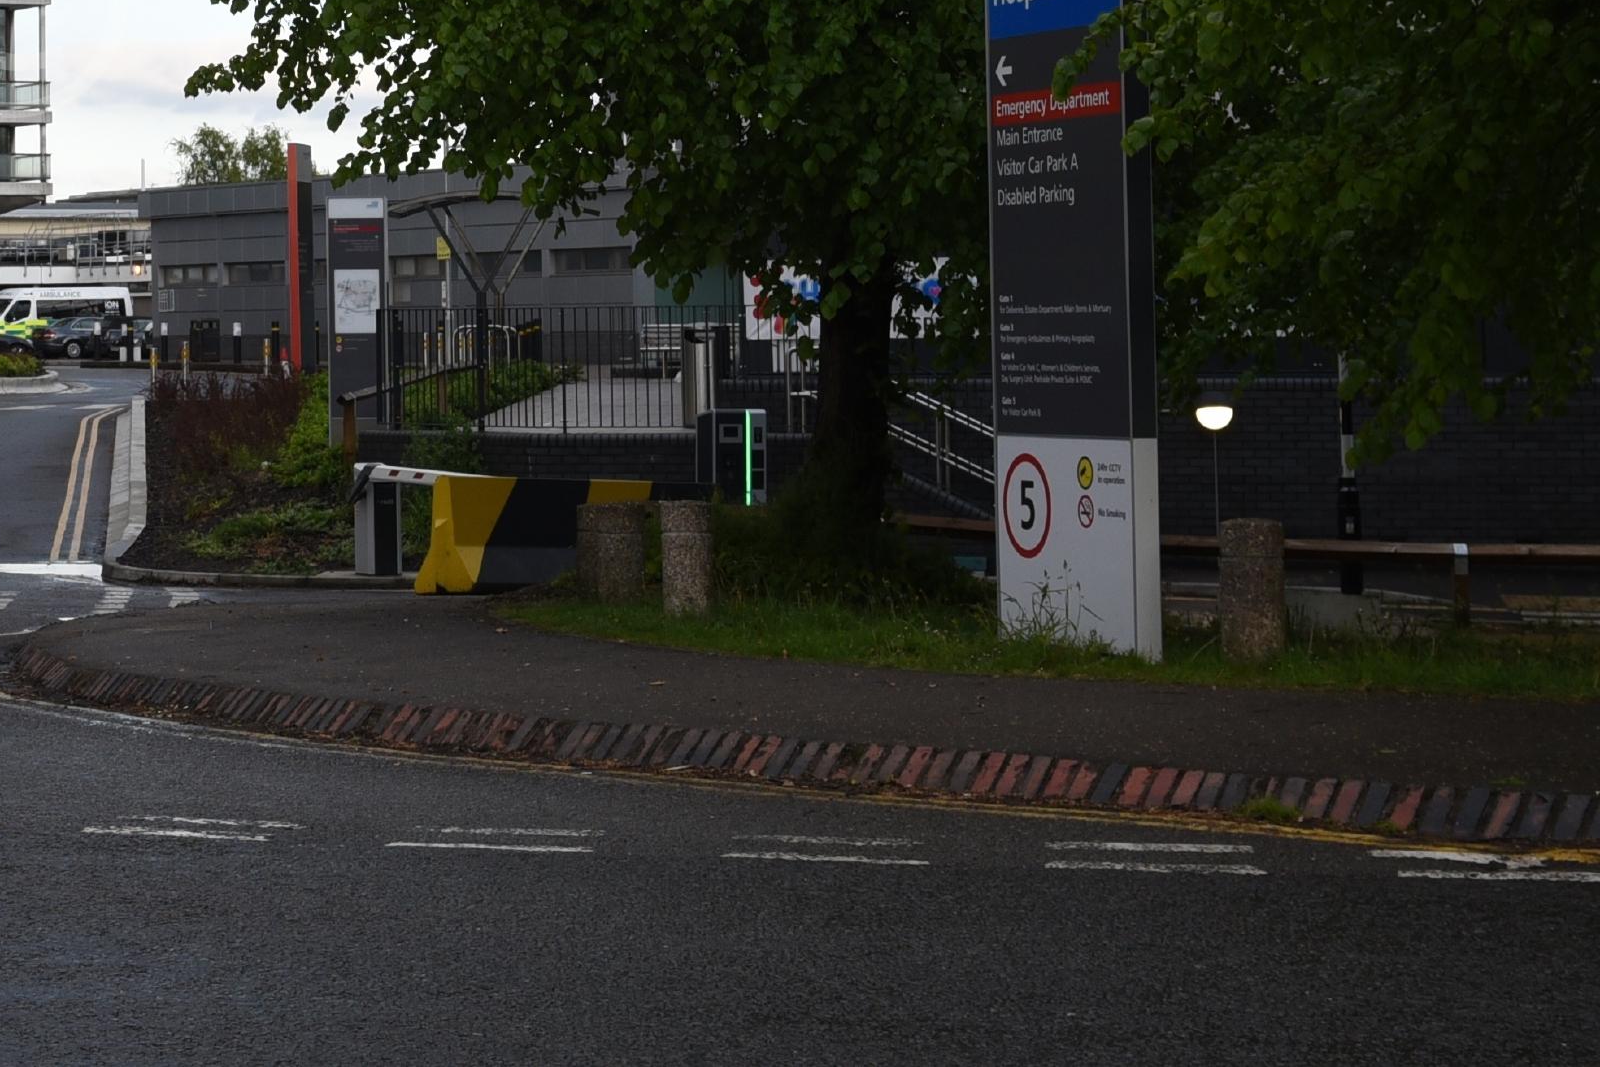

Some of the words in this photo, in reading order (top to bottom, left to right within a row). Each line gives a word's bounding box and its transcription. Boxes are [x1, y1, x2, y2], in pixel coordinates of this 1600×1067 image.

[996, 98, 1047, 119] Emergency
[996, 128, 1020, 146] Main
[1022, 127, 1063, 144] Entrance
[996, 158, 1026, 176] Visitor
[1028, 156, 1044, 174] Car
[1046, 153, 1068, 172] Park
[1070, 152, 1079, 170] A
[997, 185, 1037, 206] Disabled
[1039, 183, 1075, 206] Parking
[1108, 463, 1121, 473] CCTV
[1102, 477, 1125, 485] operation
[1021, 480, 1035, 530] 5
[1098, 508, 1106, 517] No
[1106, 508, 1127, 521] Smoking
